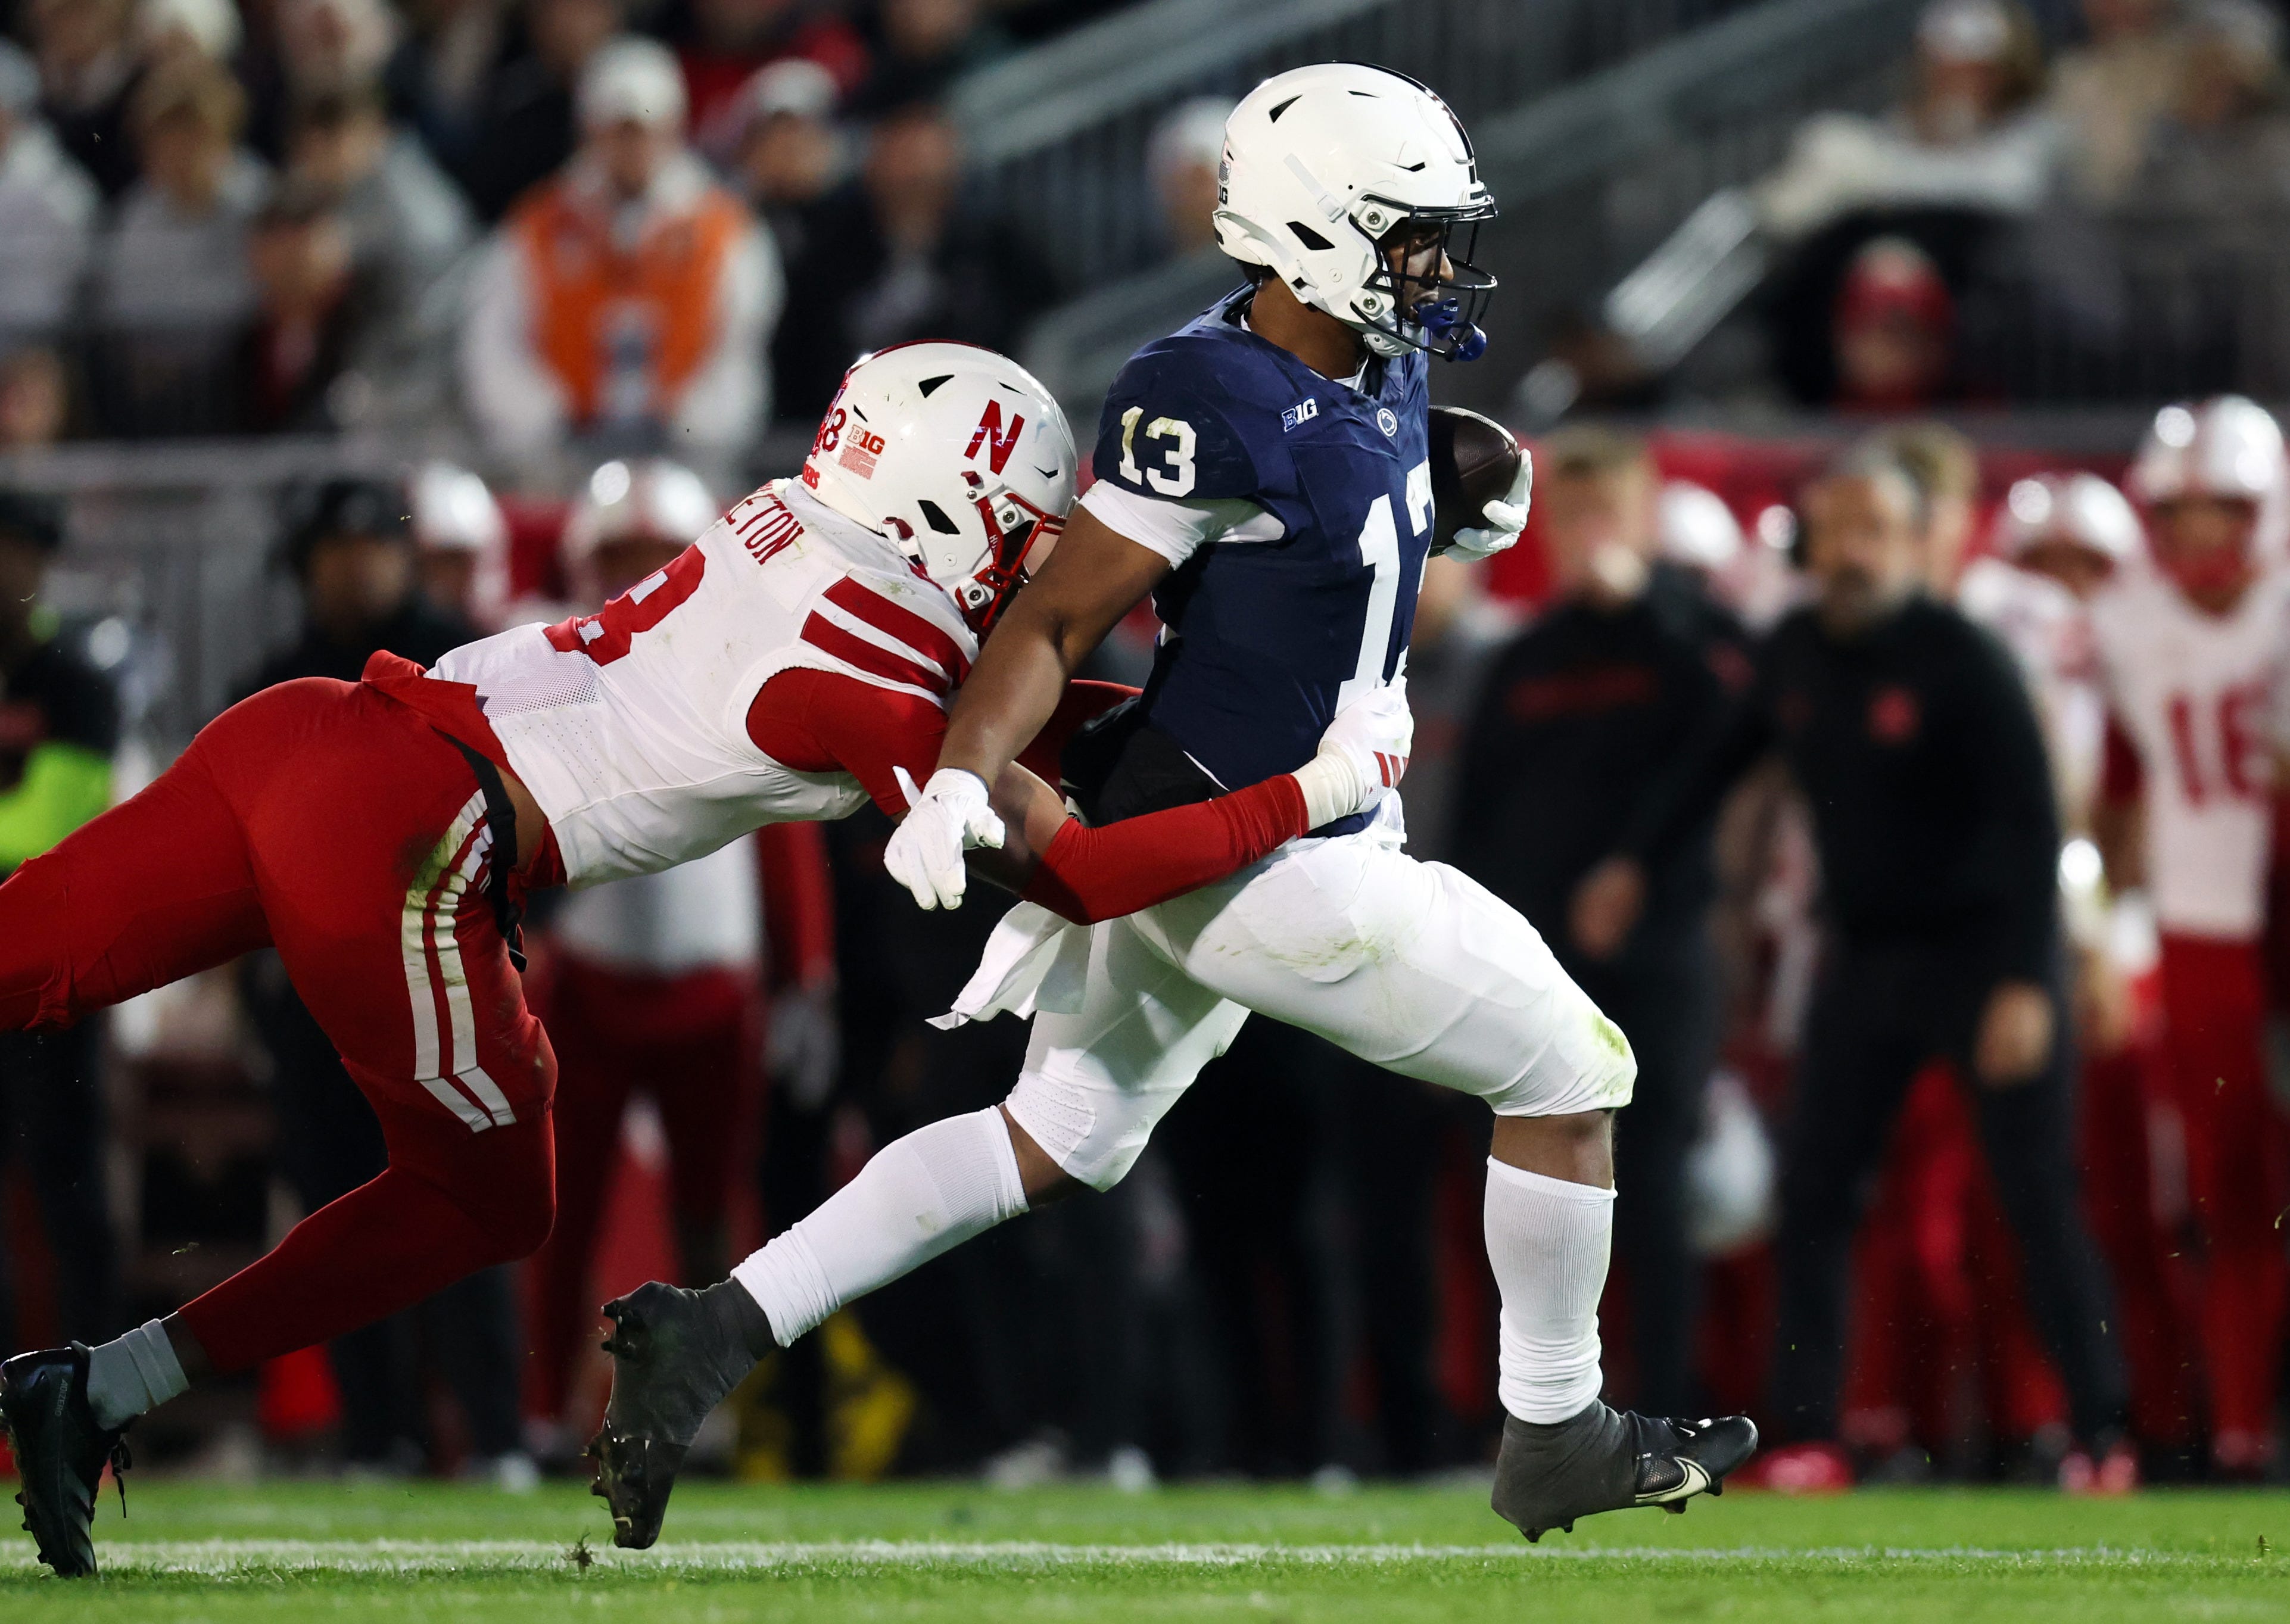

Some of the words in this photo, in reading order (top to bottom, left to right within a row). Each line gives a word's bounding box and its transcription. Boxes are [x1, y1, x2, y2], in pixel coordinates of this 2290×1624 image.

[964, 399, 1025, 475] N
[1119, 406, 1197, 497] 13
[54, 1378, 68, 1417] ADIZERO
